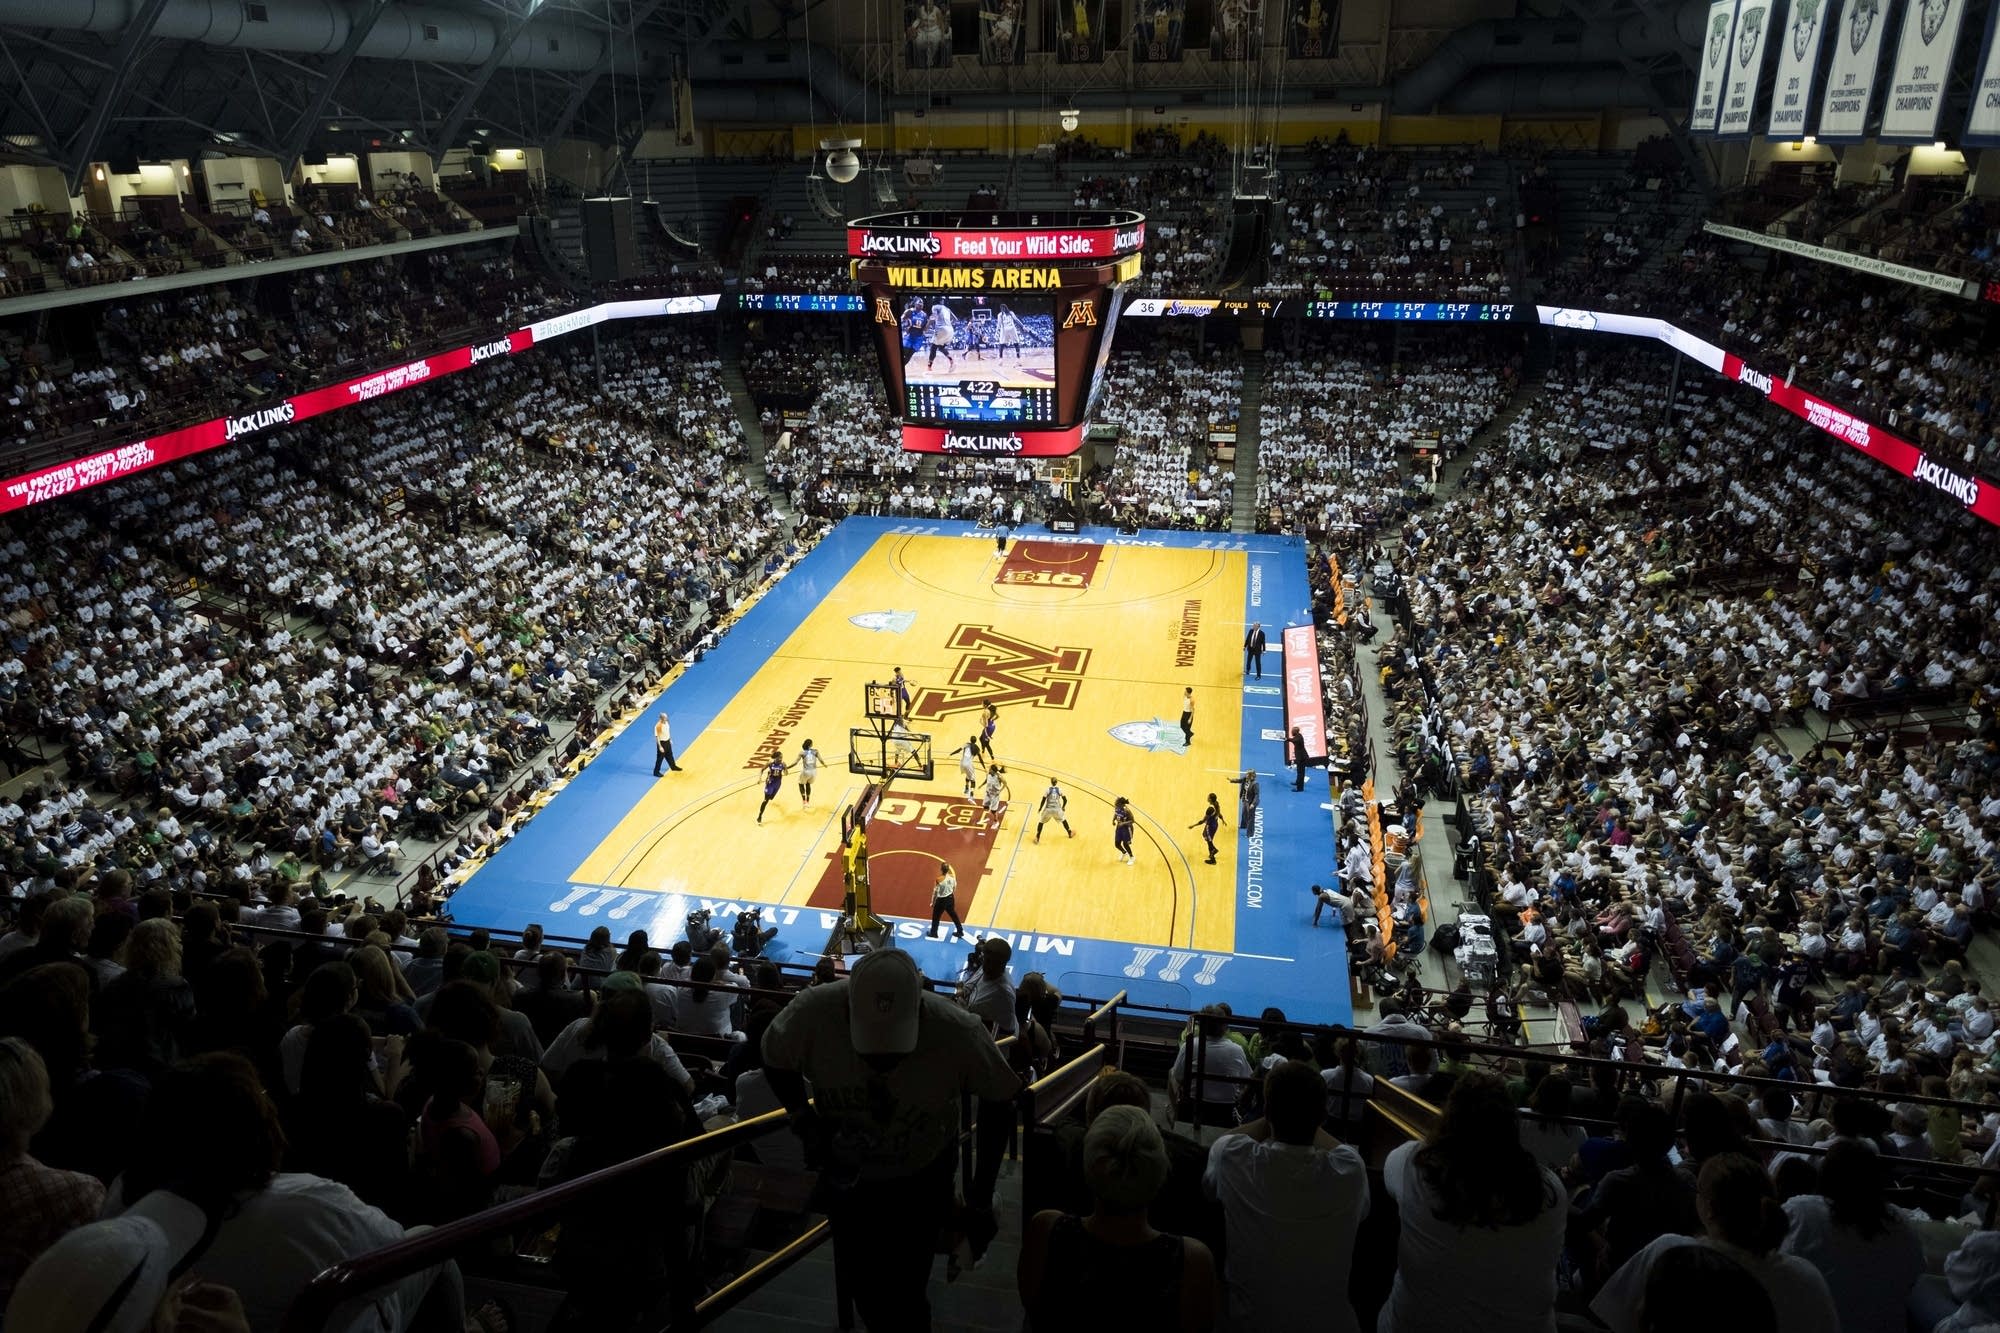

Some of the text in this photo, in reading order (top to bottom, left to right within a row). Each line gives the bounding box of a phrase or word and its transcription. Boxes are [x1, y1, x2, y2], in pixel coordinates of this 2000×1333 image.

[1912, 66, 1929, 80] 2012
[1830, 100, 1860, 113] CHAMPIONS
[1896, 97, 1933, 111] CHAMPIONS
[861, 233, 941, 254] JACK LINK'S
[954, 237, 988, 255] Feed
[990, 237, 1022, 255] Your
[1026, 236, 1057, 254] Wild
[887, 268, 1062, 288] WILLIAMS ARENA
[1063, 302, 1097, 328] M
[1141, 303, 1154, 312] 36
[966, 382, 994, 394] 4:22
[950, 398, 960, 406] 25
[1002, 400, 1014, 408] 36
[225, 403, 295, 440] JACK LINK'S
[942, 433, 1023, 451] JACK LINK'S
[7, 482, 28, 498] THE
[29, 466, 75, 491] PROTEIN
[27, 449, 154, 505] PACKED WITH PROTEIN
[1912, 454, 1978, 507] JACK LINK'S
[960, 531, 1165, 547] MINNESOTA LYNX
[1175, 600, 1202, 668] WILLIAMS ARENA
[742, 677, 832, 770] WILLIAMS ARENA
[700, 899, 1075, 956] MINNESA LYNX
